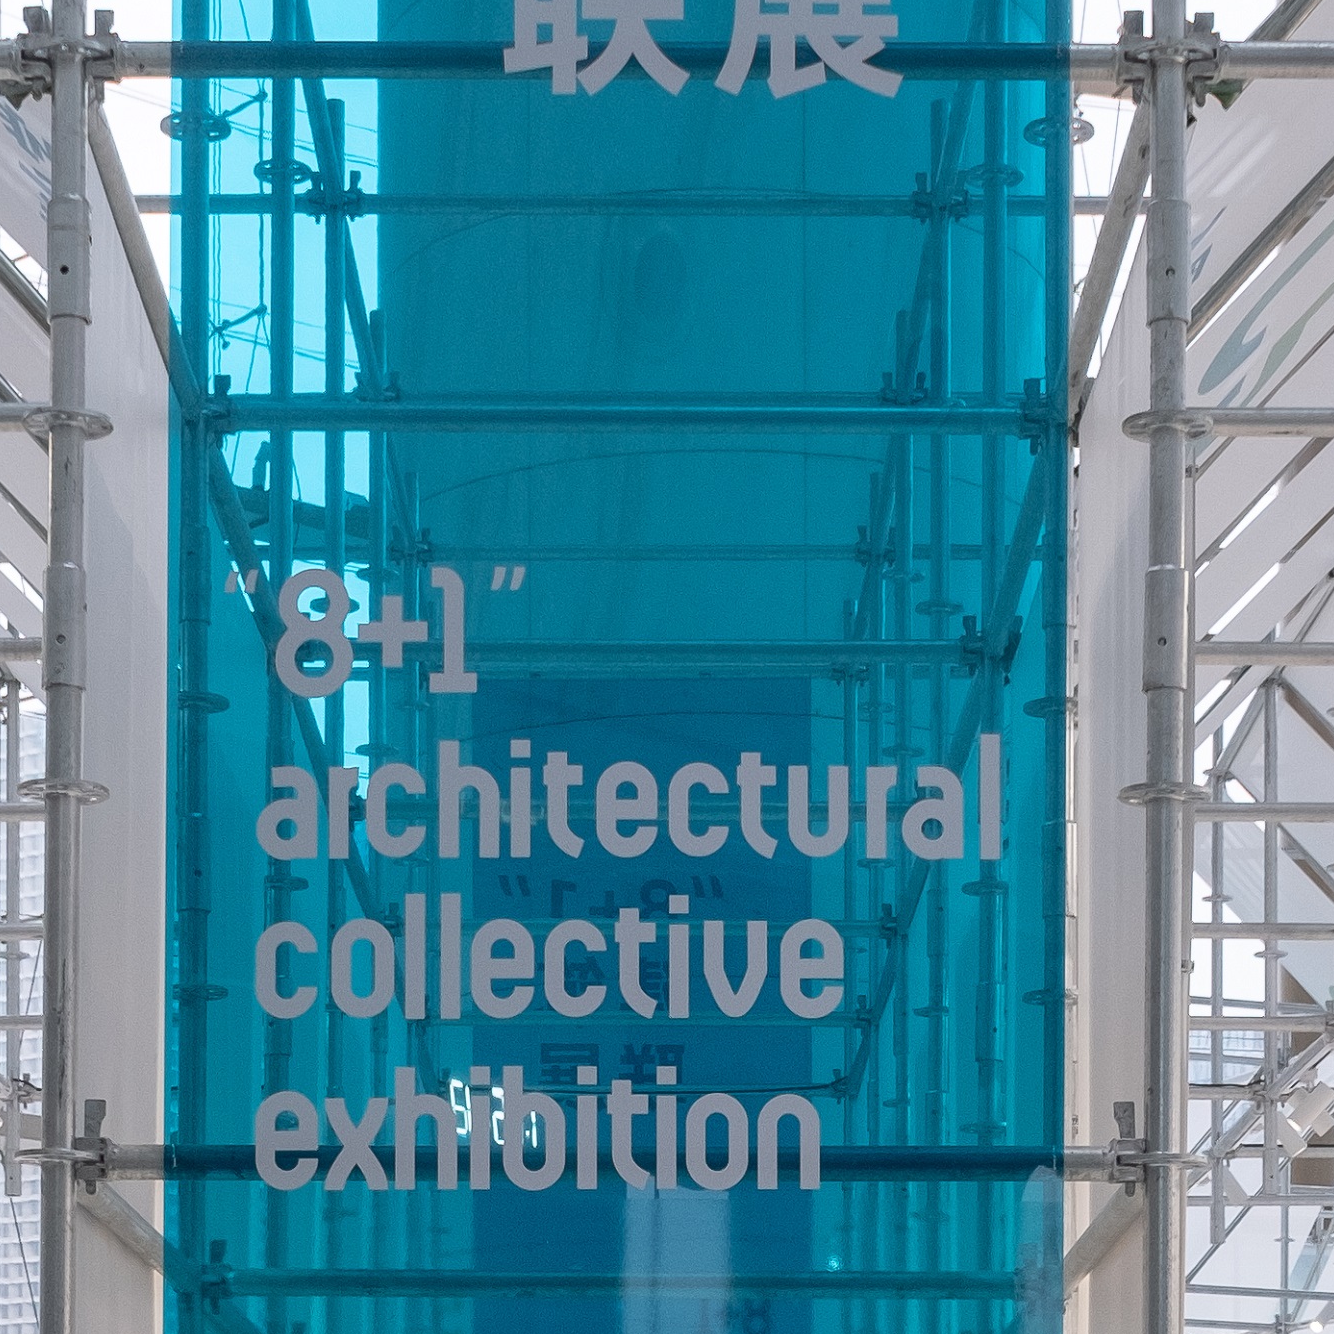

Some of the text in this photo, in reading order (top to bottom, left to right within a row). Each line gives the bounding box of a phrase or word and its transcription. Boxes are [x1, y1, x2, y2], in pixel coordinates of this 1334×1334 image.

[255, 733, 1003, 861] architectural
[254, 892, 845, 1020] collective
[254, 1065, 821, 1192] exhibition
